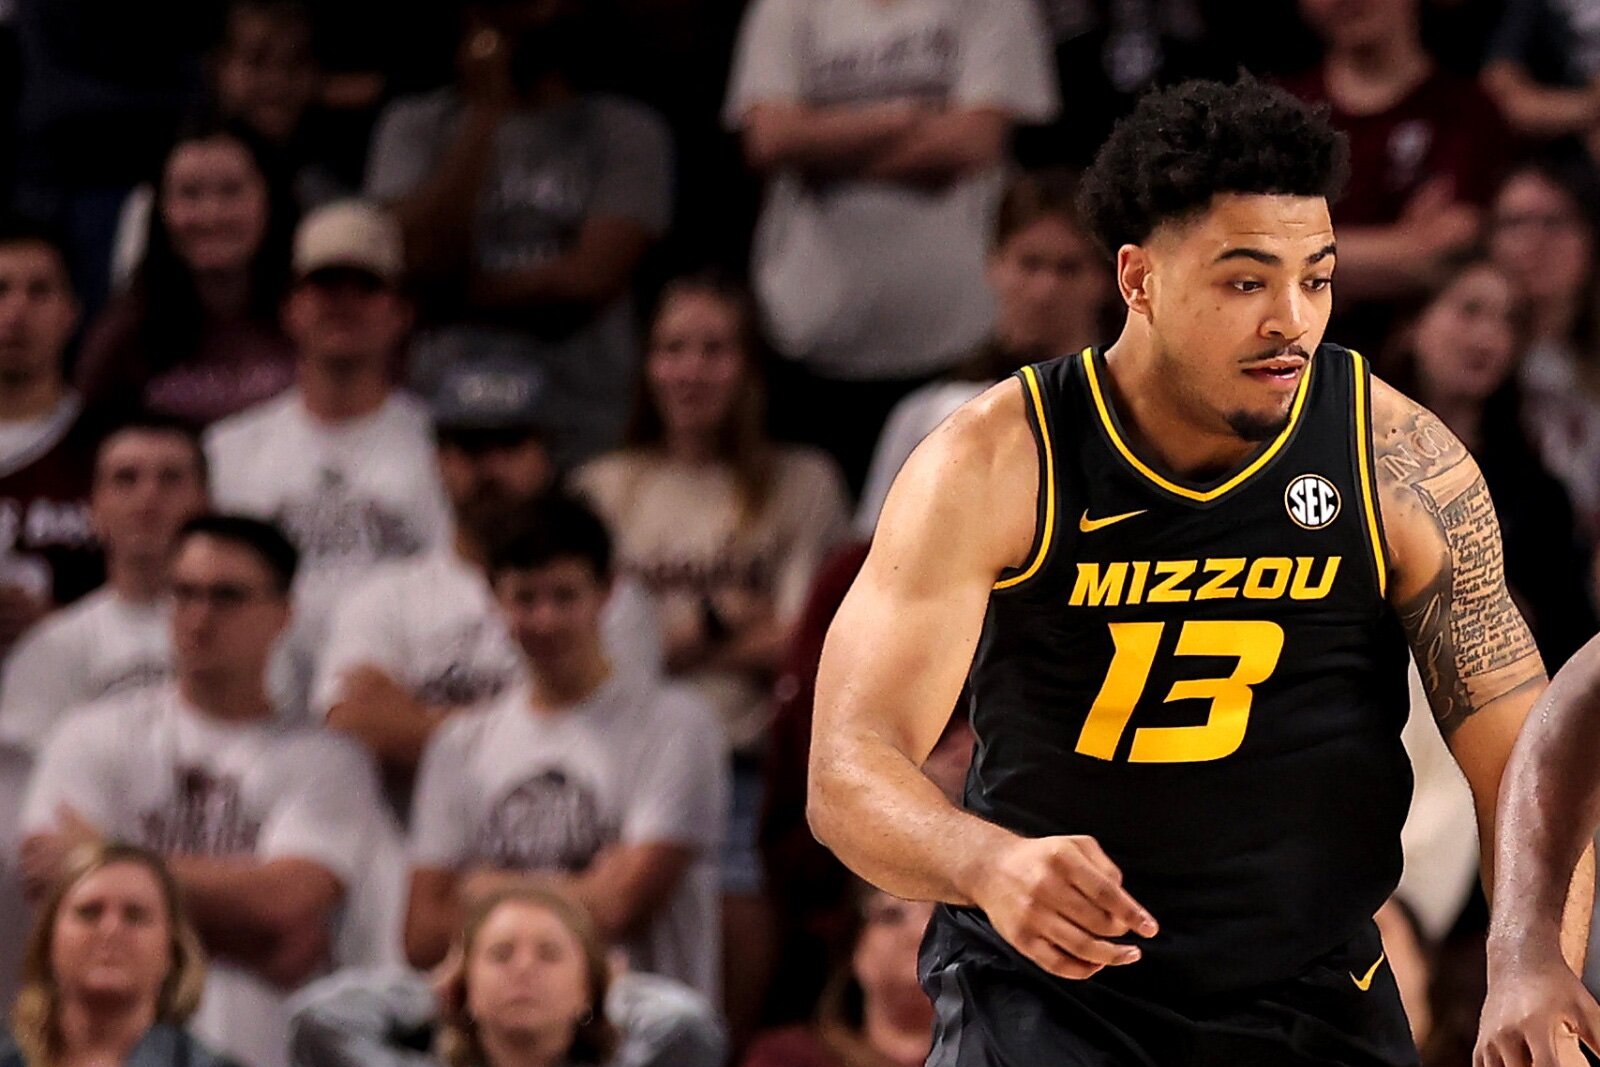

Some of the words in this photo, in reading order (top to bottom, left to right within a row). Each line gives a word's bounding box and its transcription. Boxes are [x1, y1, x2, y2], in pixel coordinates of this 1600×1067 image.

[1289, 478, 1335, 525] SEC
[1068, 556, 1342, 606] MIZZOU
[1075, 620, 1285, 763] 13
